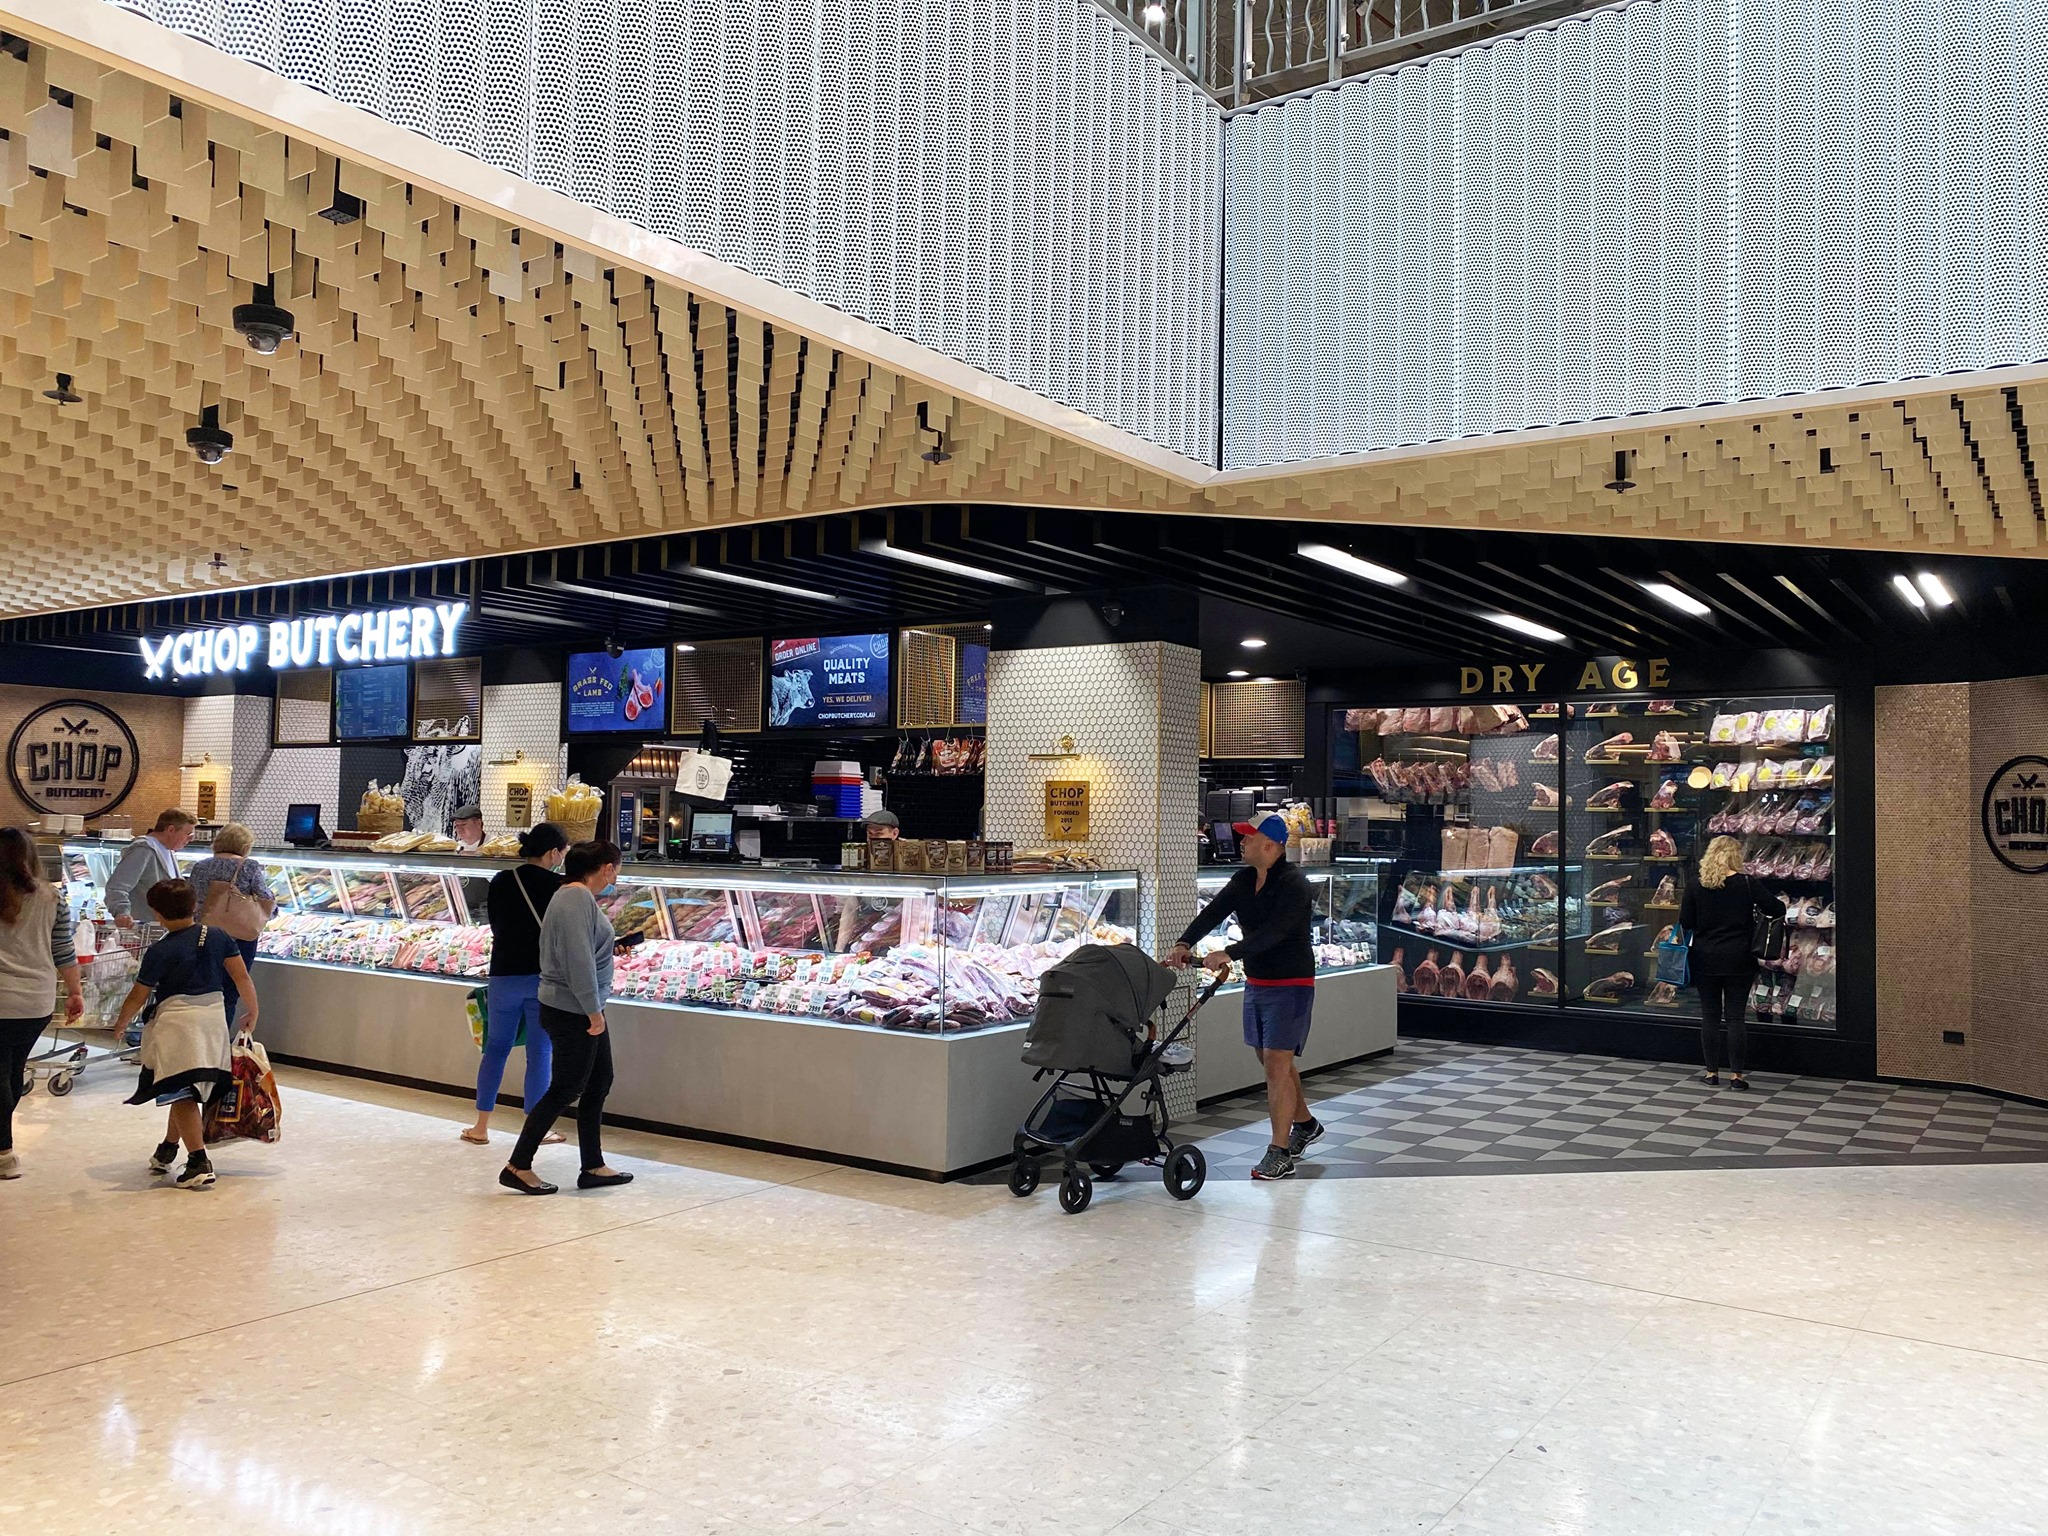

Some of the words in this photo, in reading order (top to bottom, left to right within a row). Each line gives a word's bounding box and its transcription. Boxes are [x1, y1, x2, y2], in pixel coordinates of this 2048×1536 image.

[172, 625, 259, 675] CHOP
[268, 602, 467, 668] BUTCHERY
[774, 648, 794, 662] ORDER
[796, 642, 816, 656] ONLINE
[824, 657, 870, 672] QUALITY
[828, 672, 866, 684] MEATS
[1460, 663, 1545, 694] DRY
[1576, 657, 1671, 690] AGE
[572, 676, 596, 692] GRASS
[600, 678, 614, 690] FED
[584, 688, 602, 696] LAMB
[846, 694, 872, 702] DELIVER!
[27, 742, 122, 782] CHOP
[46, 787, 105, 798] BUTCHERY
[509, 787, 528, 796] CHOP
[1050, 788, 1084, 798] CHOP
[1994, 796, 2048, 835] CHO
